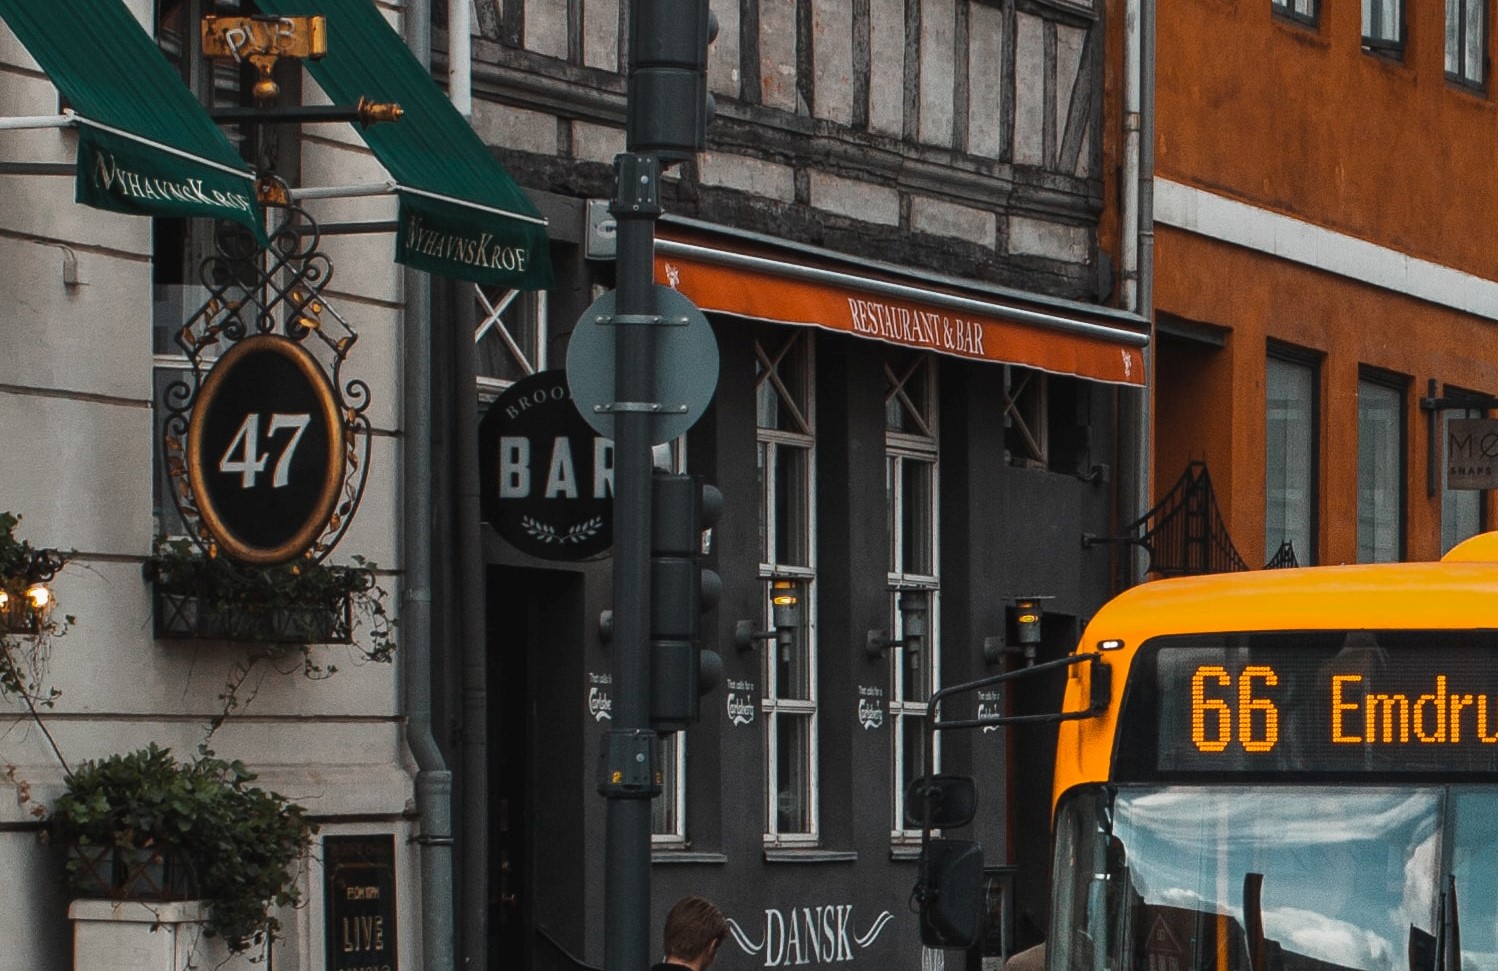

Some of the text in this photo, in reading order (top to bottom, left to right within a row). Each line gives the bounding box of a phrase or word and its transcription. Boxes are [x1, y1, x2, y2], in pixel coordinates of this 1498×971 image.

[226, 17, 296, 63] PUB
[847, 297, 985, 355] RESTAURANT & BAR
[505, 385, 564, 420] BROO
[218, 412, 311, 489] 47
[500, 436, 615, 499] BAR
[1450, 466, 1492, 477] SNAPS
[1192, 666, 1279, 752] 66
[343, 915, 384, 952] LIVE
[764, 904, 854, 967] DANSK
